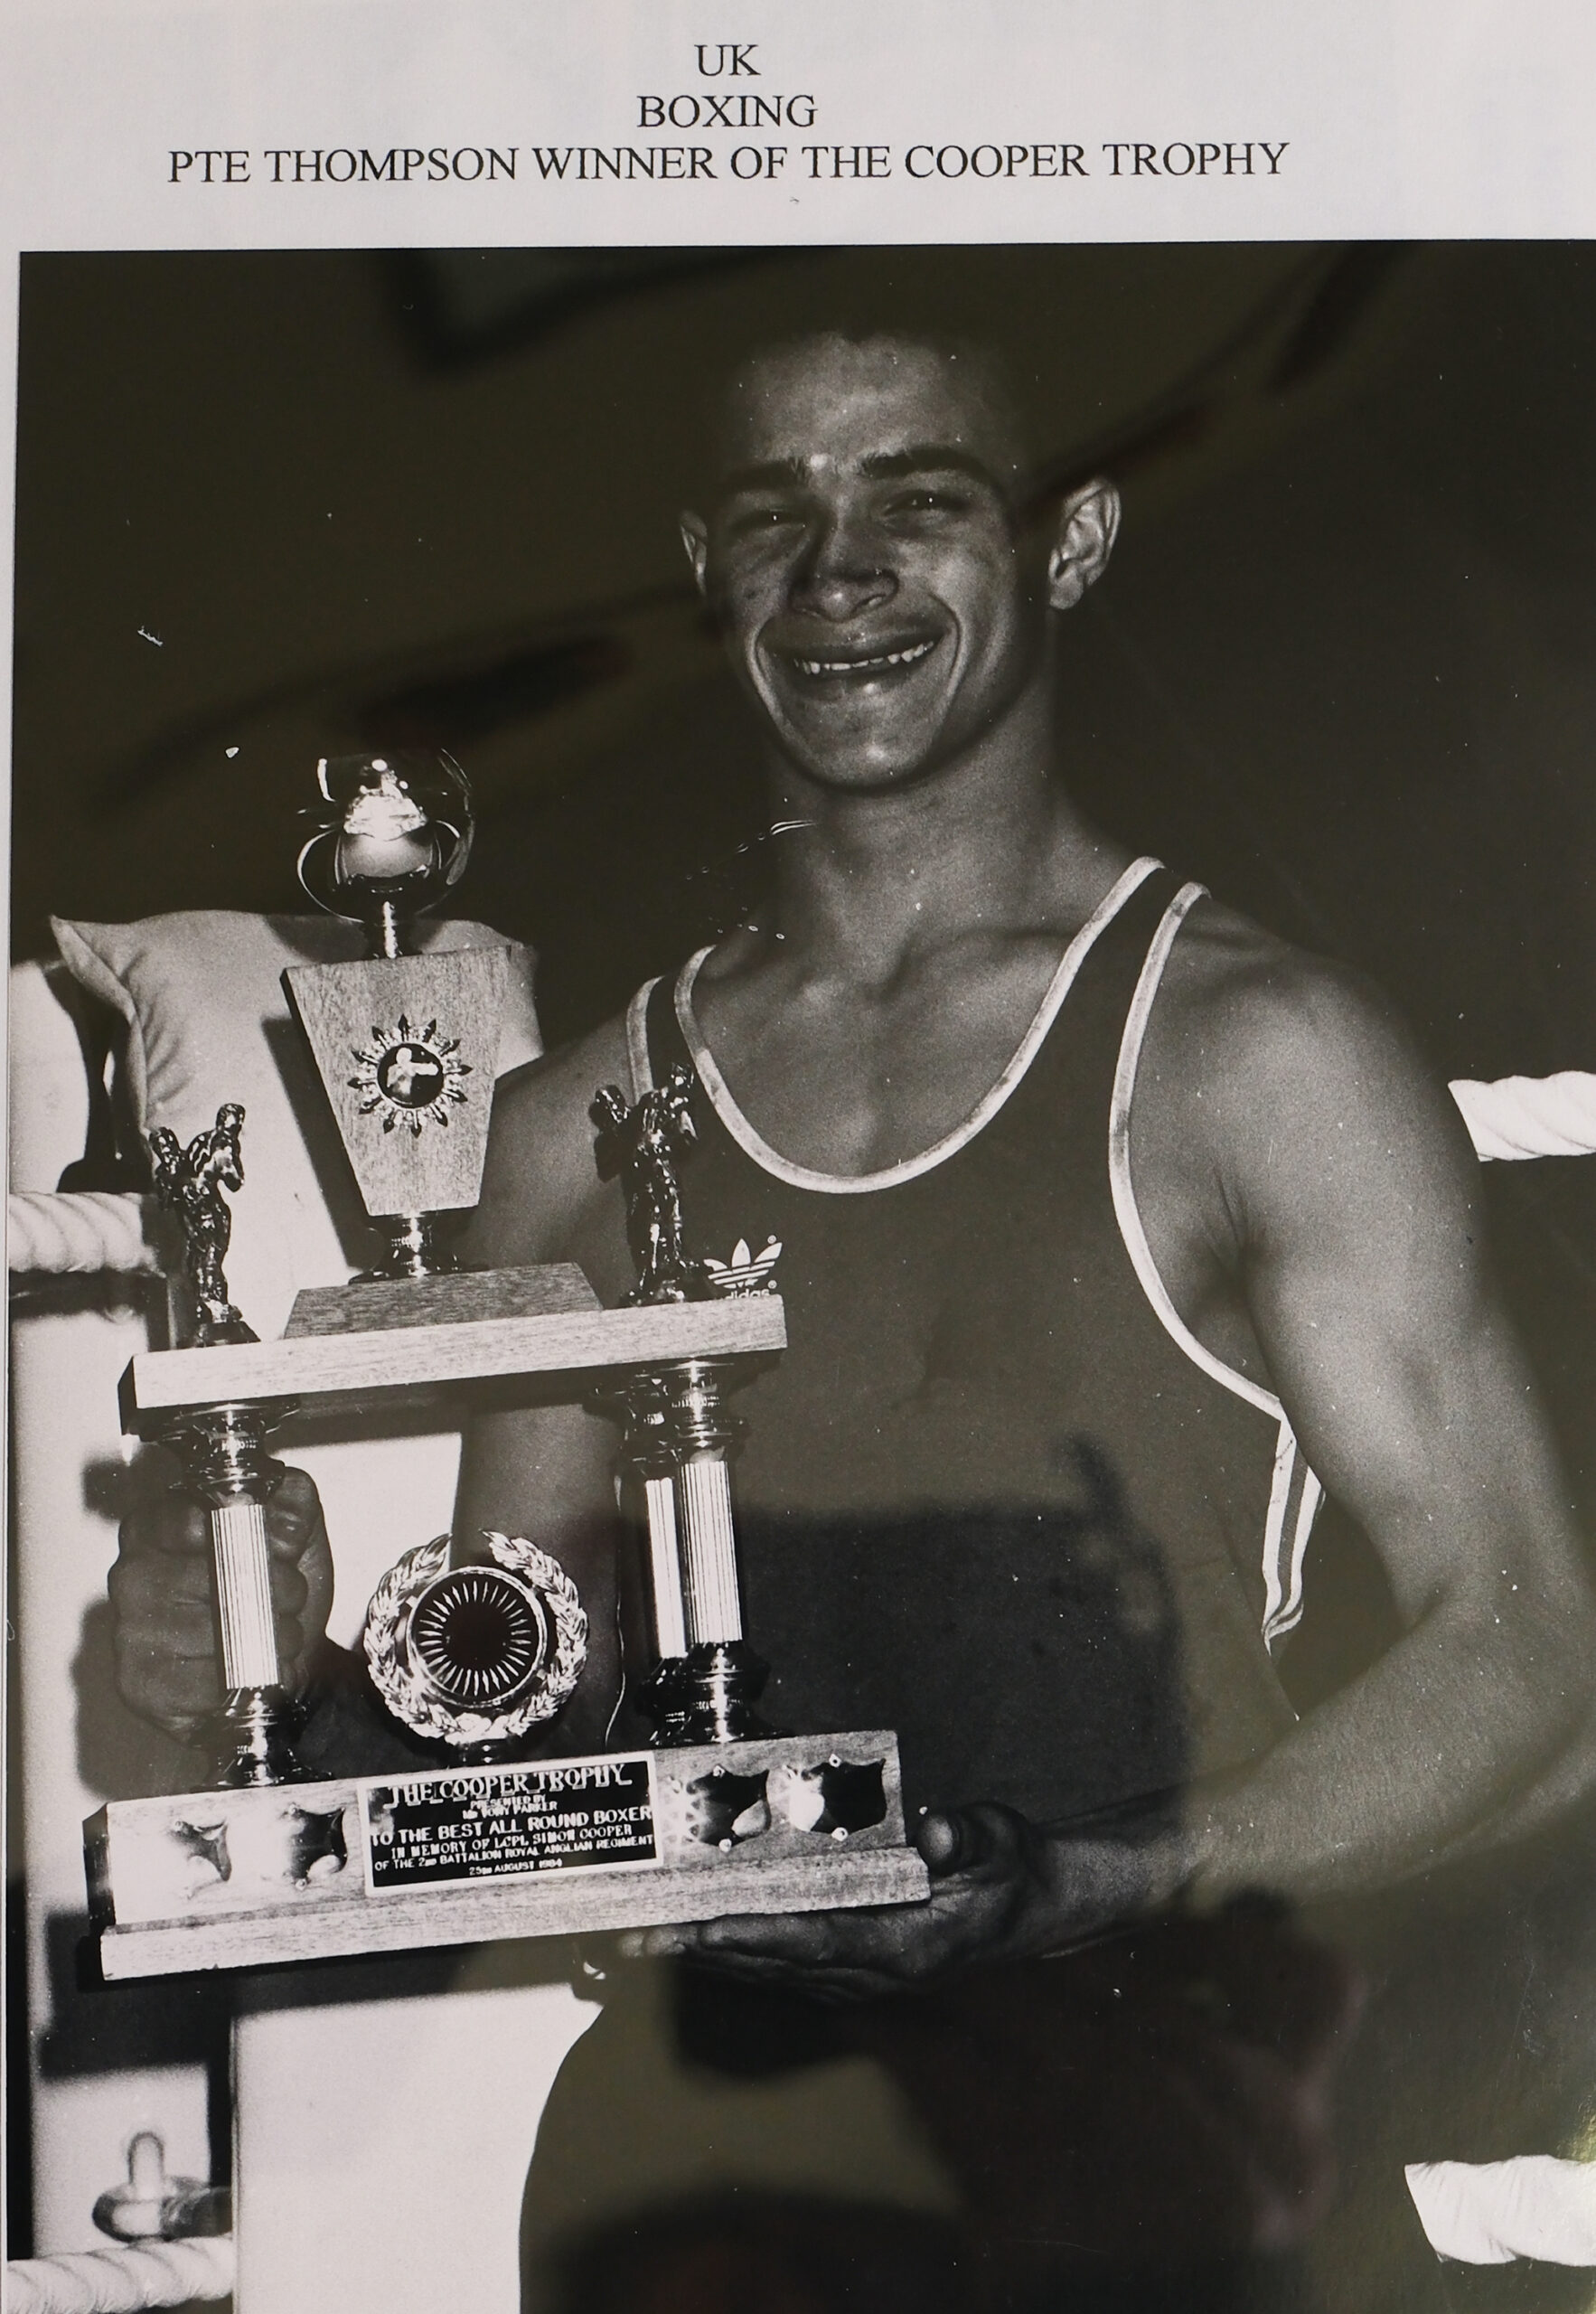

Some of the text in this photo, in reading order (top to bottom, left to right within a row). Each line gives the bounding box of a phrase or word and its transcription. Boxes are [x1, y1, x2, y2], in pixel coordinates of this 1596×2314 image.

[695, 44, 760, 76] UK
[638, 95, 817, 127] BOXING
[169, 143, 1289, 182] PTE THOMPSON WINNER OF THE COOPER TROPHY
[720, 1288, 770, 1300] didas
[383, 1764, 632, 1809] THE COOPER TROPHY
[371, 1805, 652, 1847] TO THE BEST ALL ROUND BOXER
[391, 1847, 405, 1859] IN
[410, 1840, 466, 1858] MEMORY
[472, 1838, 490, 1850] OF
[532, 1829, 575, 1845] SIMON
[579, 1824, 632, 1839] COOPER
[374, 1860, 390, 1871] OF
[393, 1858, 415, 1869] THE
[439, 1848, 502, 1865] BATTALION
[505, 1846, 540, 1858] ROYAL
[544, 1840, 593, 1854] ANGLIAN
[596, 1835, 652, 1849] REGIMENT
[469, 1866, 493, 1877] 25
[494, 1860, 534, 1873] AUGUST
